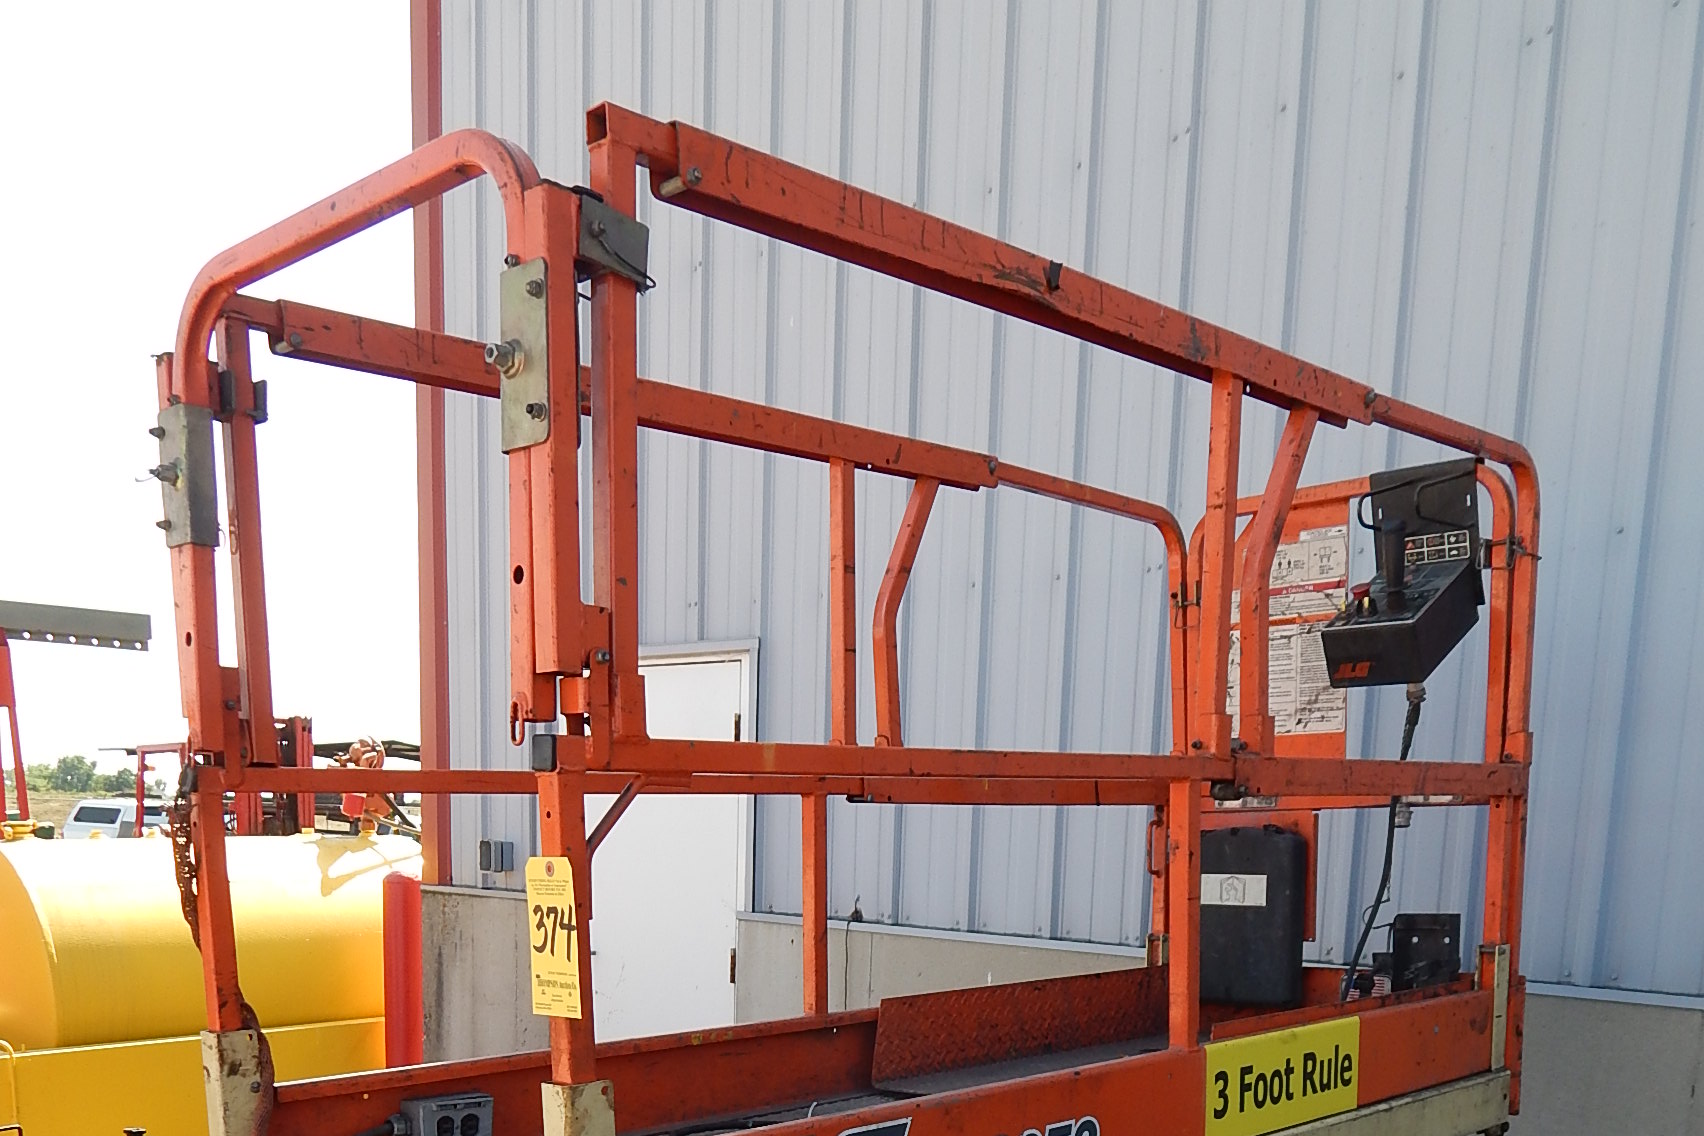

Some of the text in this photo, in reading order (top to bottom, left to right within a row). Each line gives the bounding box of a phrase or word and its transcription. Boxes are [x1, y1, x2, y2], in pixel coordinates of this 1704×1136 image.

[1333, 661, 1371, 679] JLG
[532, 903, 577, 963] 374
[1213, 1044, 1353, 1120] 3 Foot Rule
